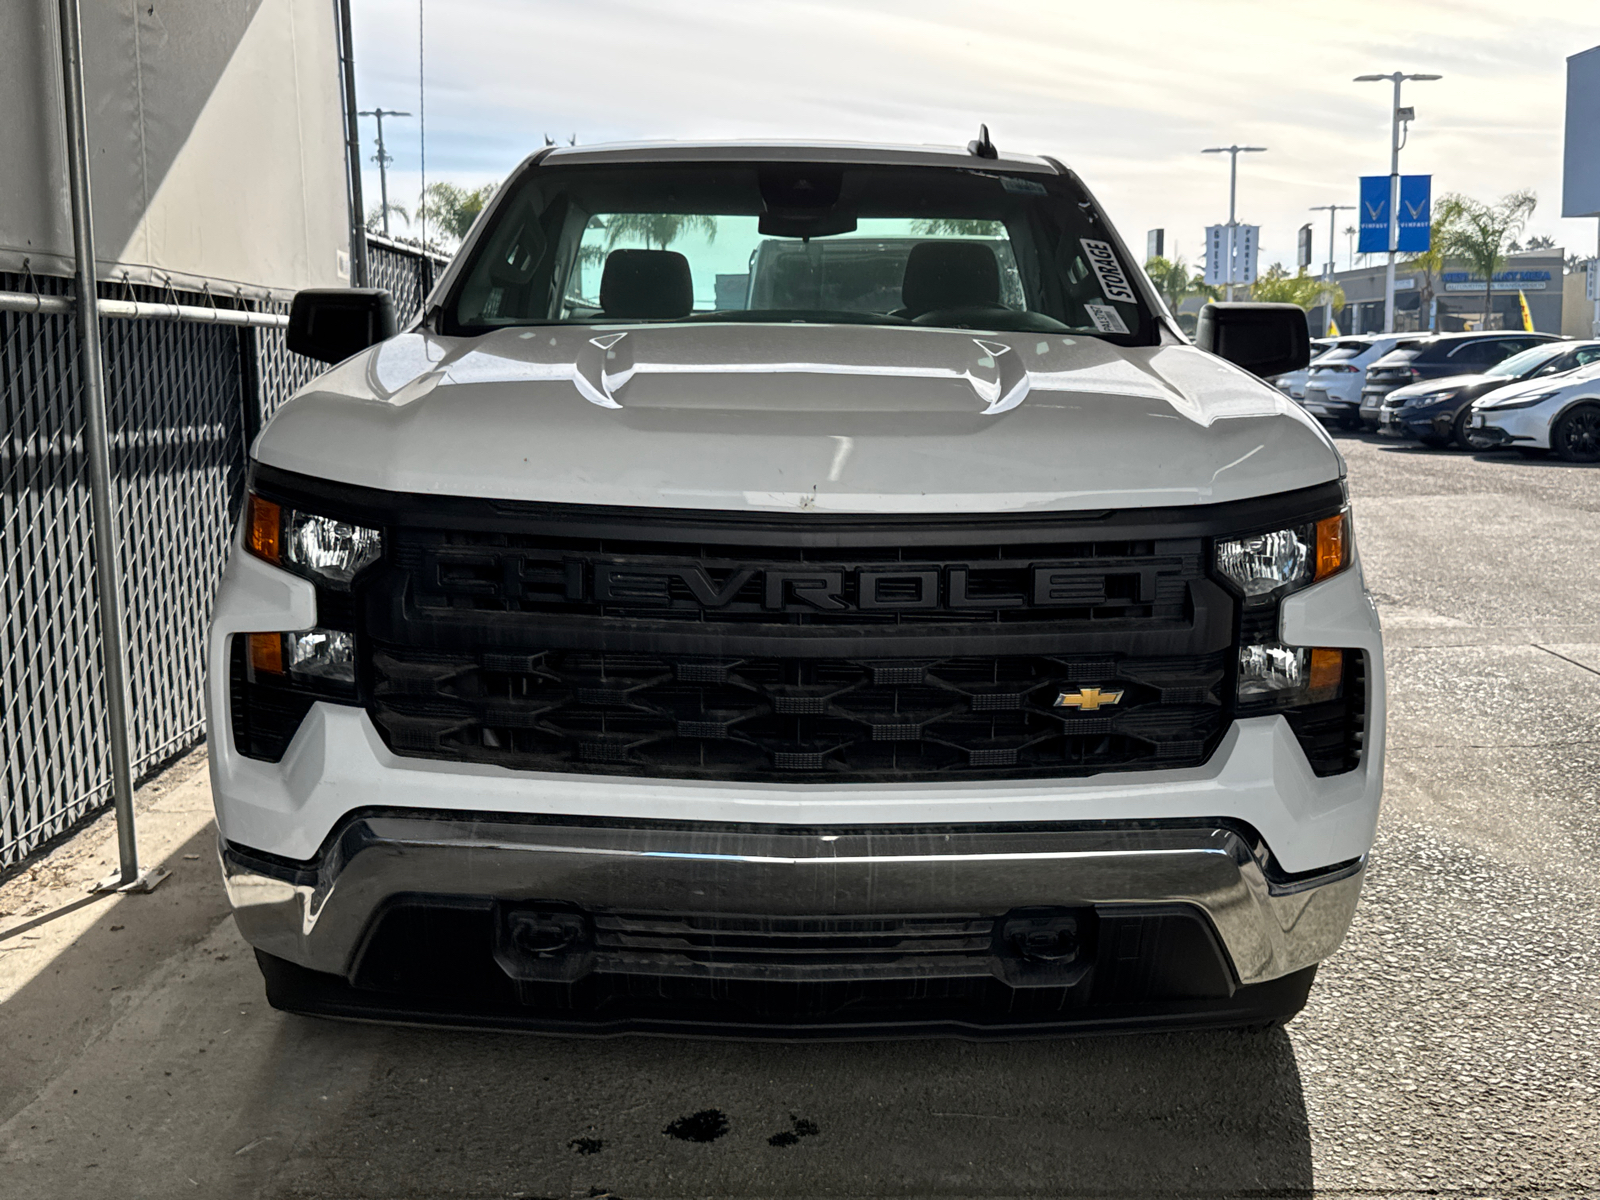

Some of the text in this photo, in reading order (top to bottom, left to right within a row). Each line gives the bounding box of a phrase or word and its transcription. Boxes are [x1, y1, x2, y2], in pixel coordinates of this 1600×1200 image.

[1086, 242, 1132, 299] STORAGE
[1520, 270, 1552, 281] MESA
[430, 547, 1183, 611] CHEVROLET
